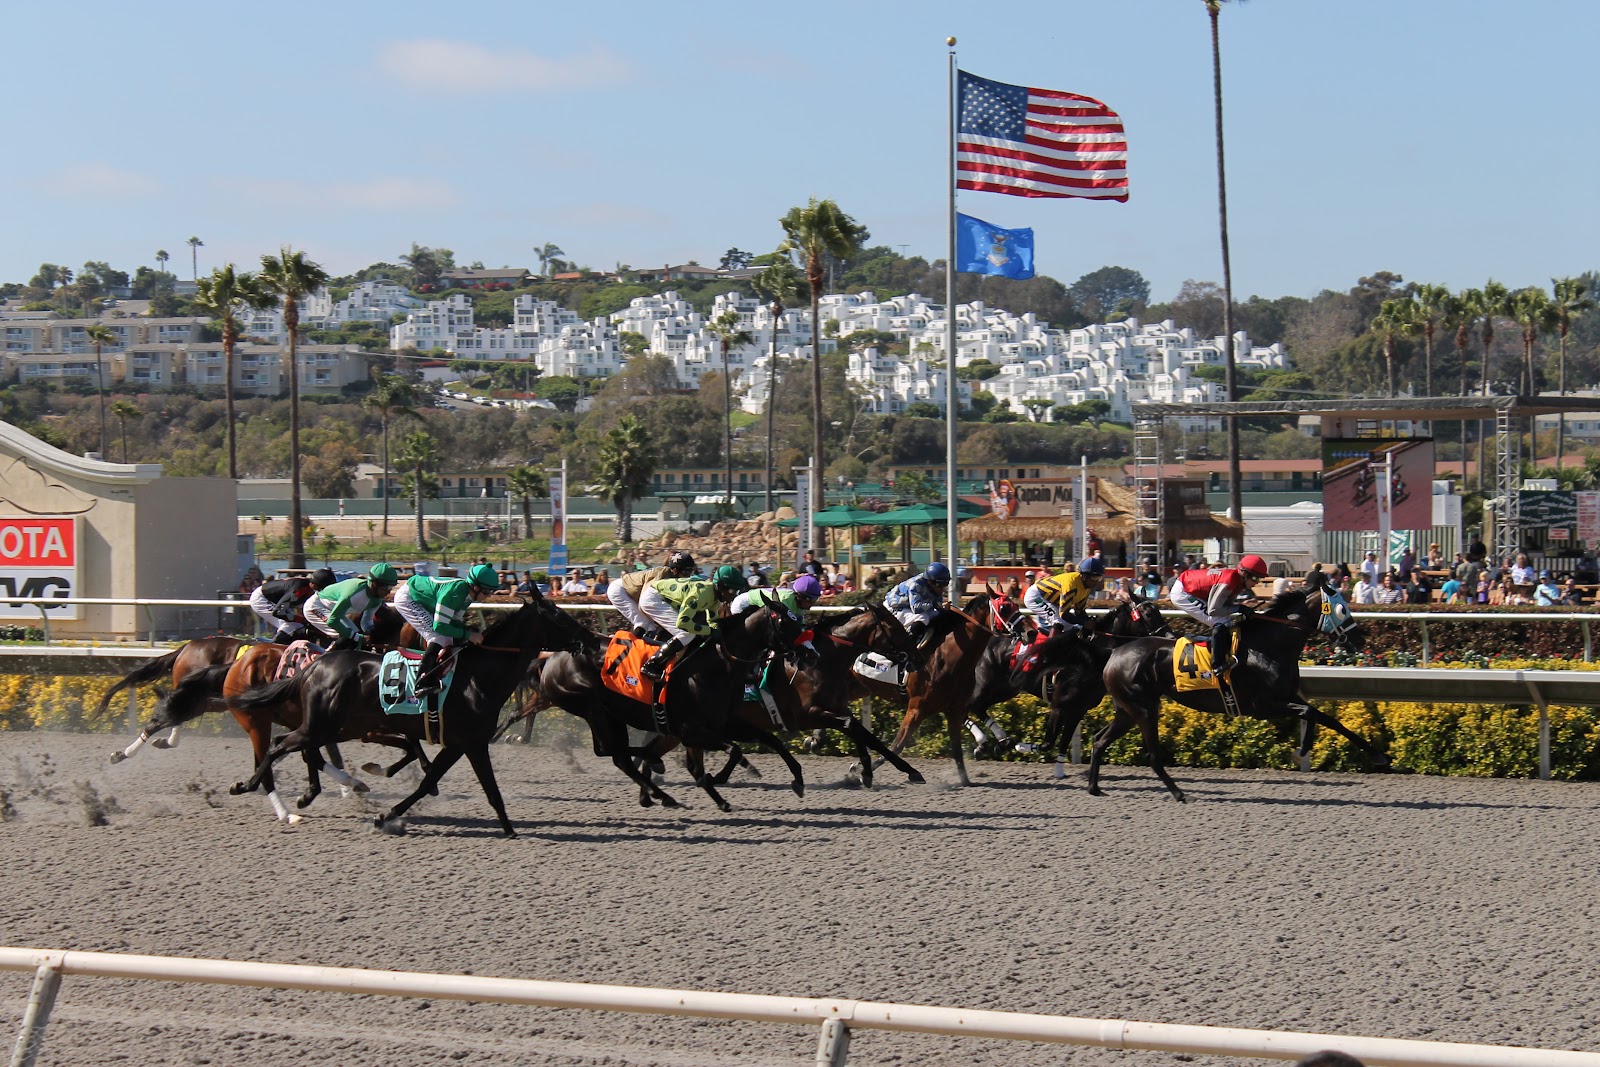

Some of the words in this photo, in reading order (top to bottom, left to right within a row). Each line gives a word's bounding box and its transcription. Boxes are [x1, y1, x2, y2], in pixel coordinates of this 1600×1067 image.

[1015, 484, 1051, 506] Captain
[1052, 485, 1093, 506] Morn
[0, 577, 71, 609] VG
[1323, 604, 1330, 613] 4
[1041, 602, 1056, 617] TVG
[607, 637, 632, 676] 7
[1178, 643, 1198, 680] 4
[383, 661, 407, 705] 9
